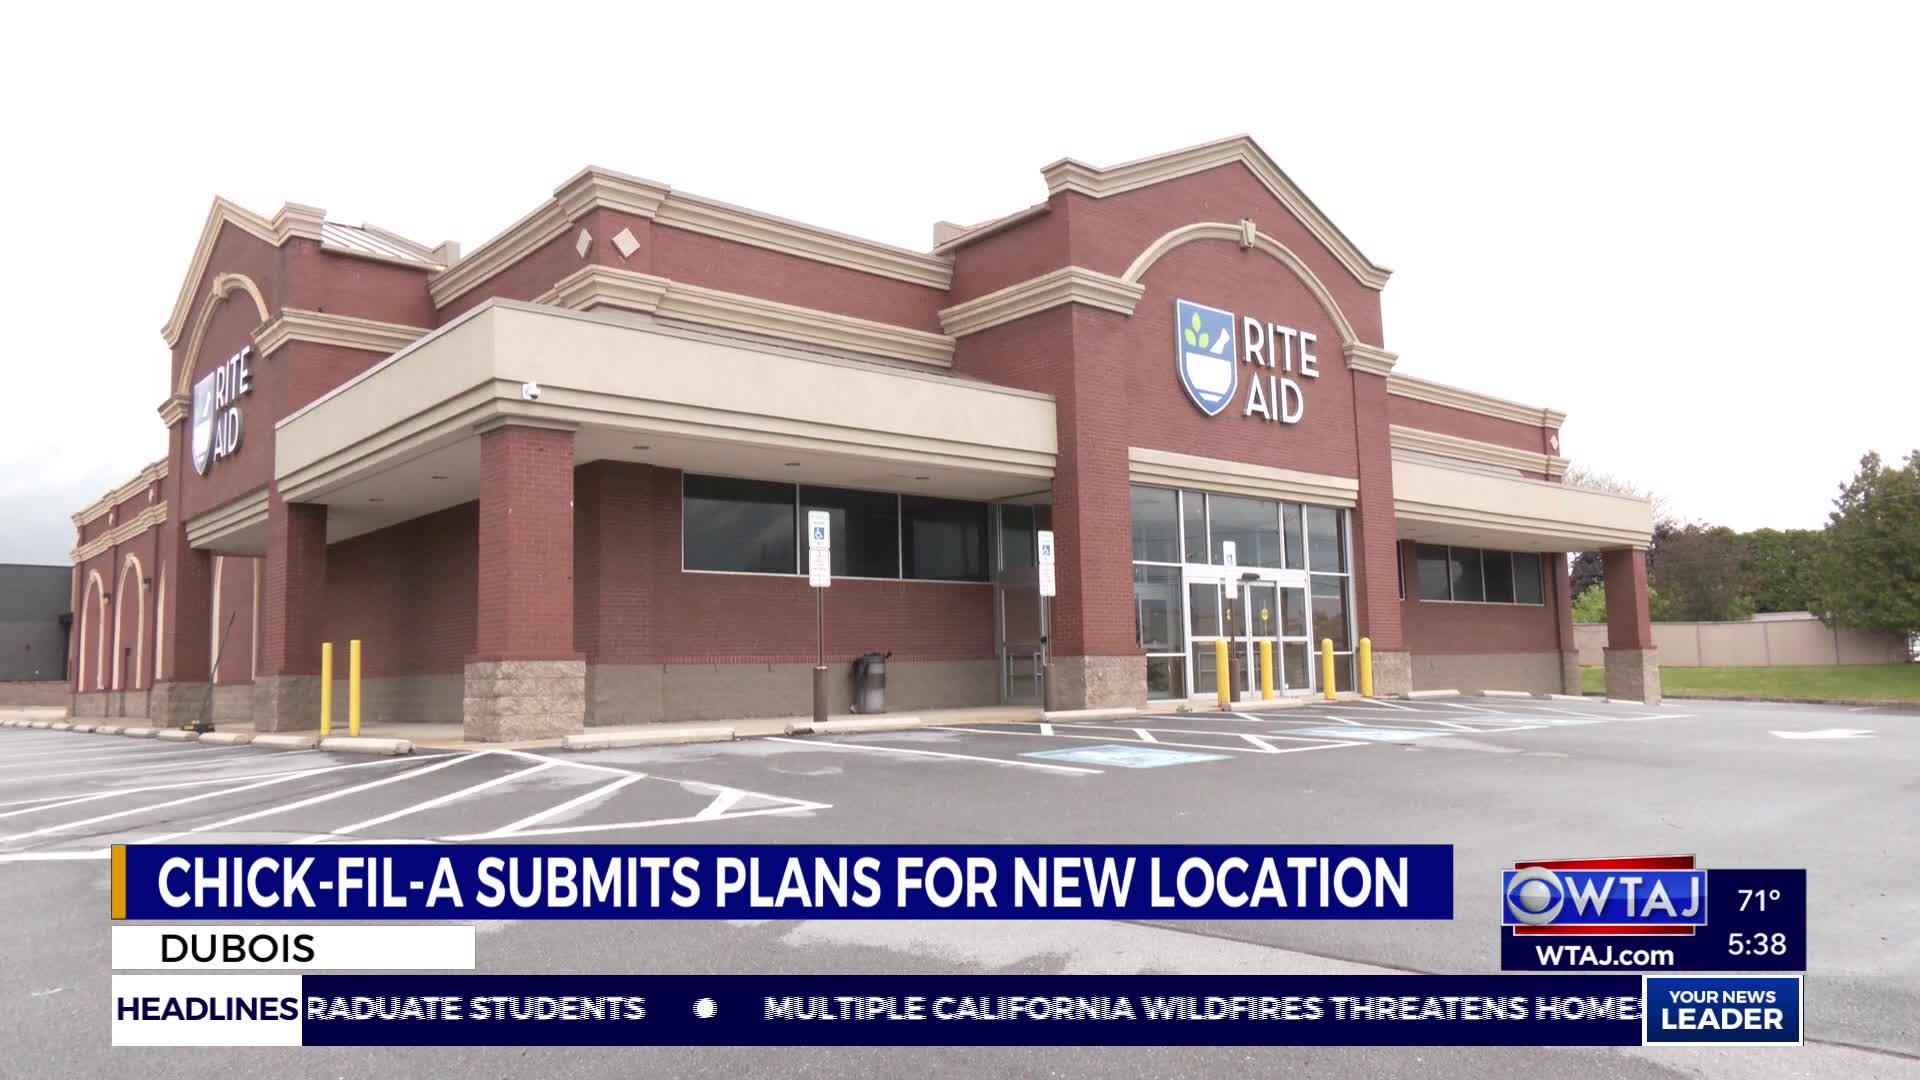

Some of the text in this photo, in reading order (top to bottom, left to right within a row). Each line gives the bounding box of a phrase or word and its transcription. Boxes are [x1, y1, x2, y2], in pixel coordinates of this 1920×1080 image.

[1242, 315, 1320, 378] RITE
[215, 345, 251, 411] RITE
[1243, 371, 1304, 424] AID
[213, 407, 241, 462] AID
